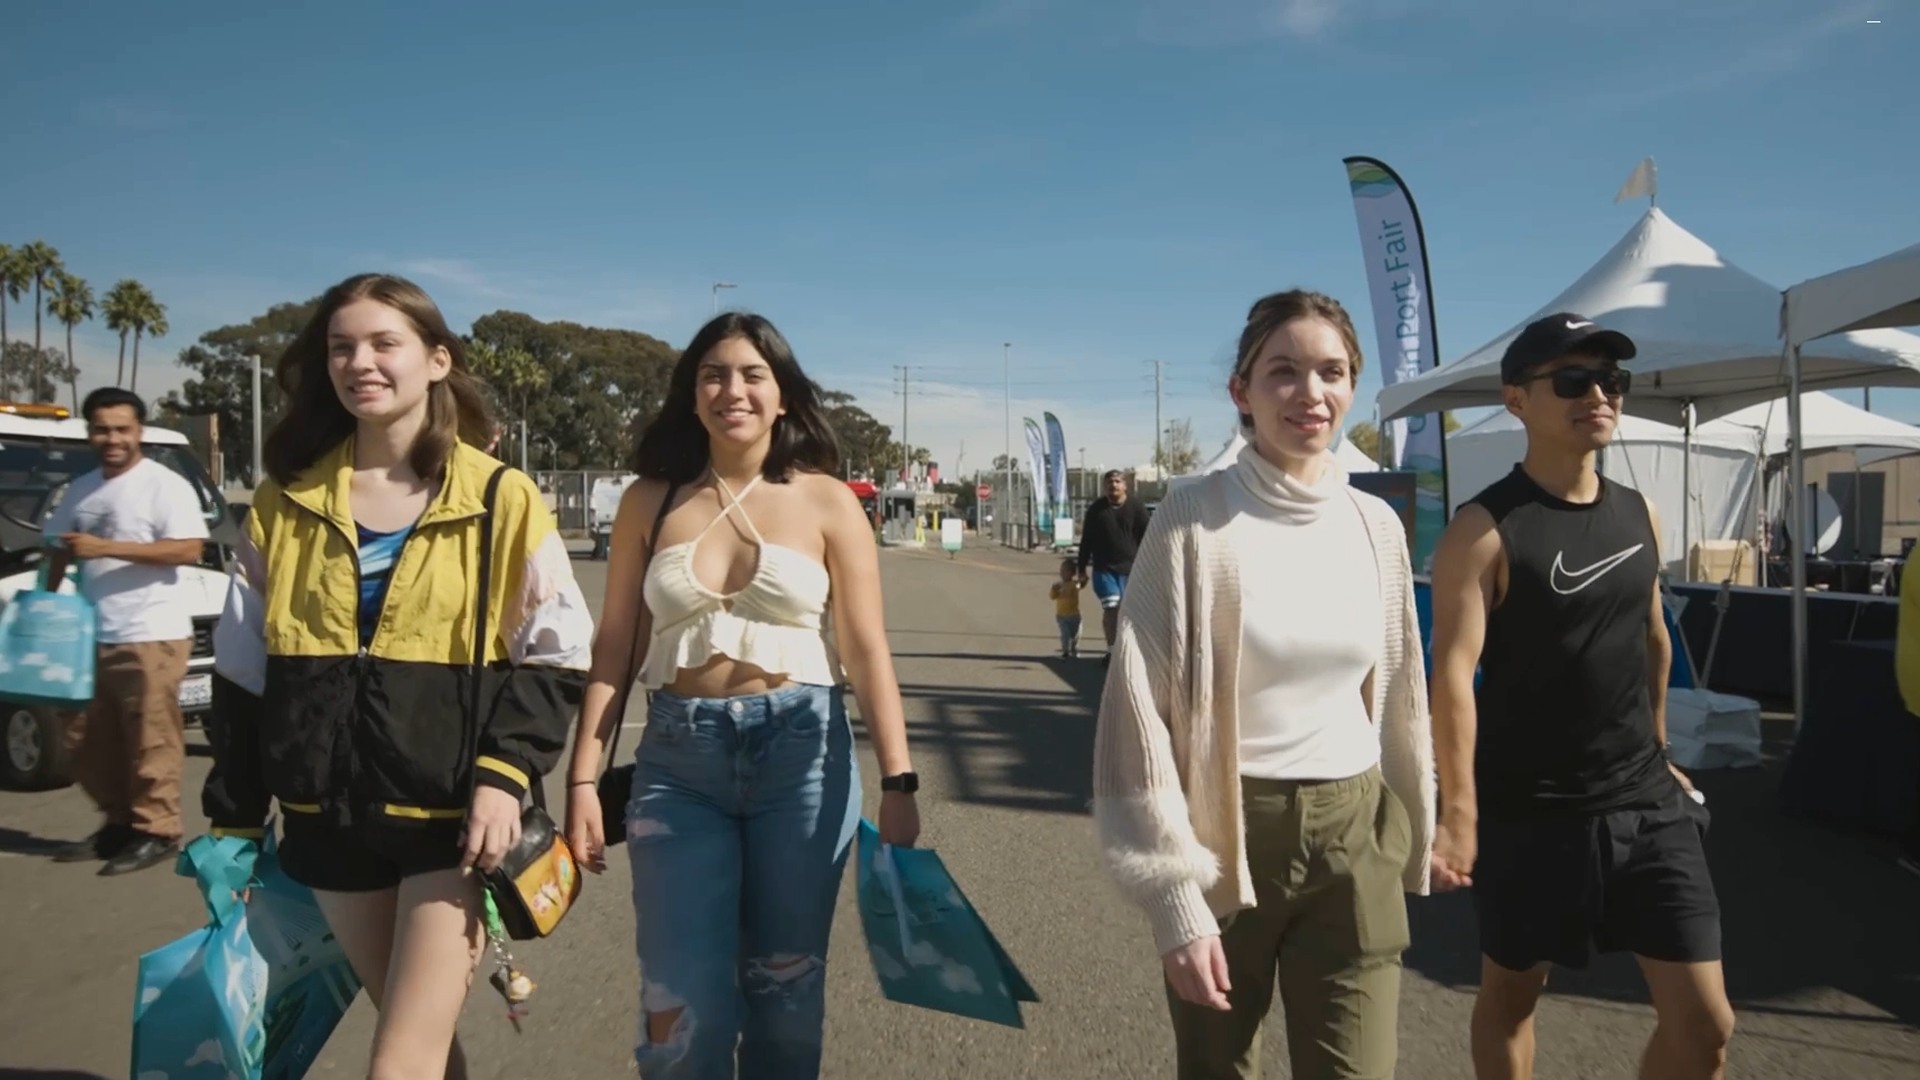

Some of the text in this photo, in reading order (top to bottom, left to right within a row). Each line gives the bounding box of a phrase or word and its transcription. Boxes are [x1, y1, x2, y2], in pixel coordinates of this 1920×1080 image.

[1378, 219, 1427, 435] Gen Port Fair
